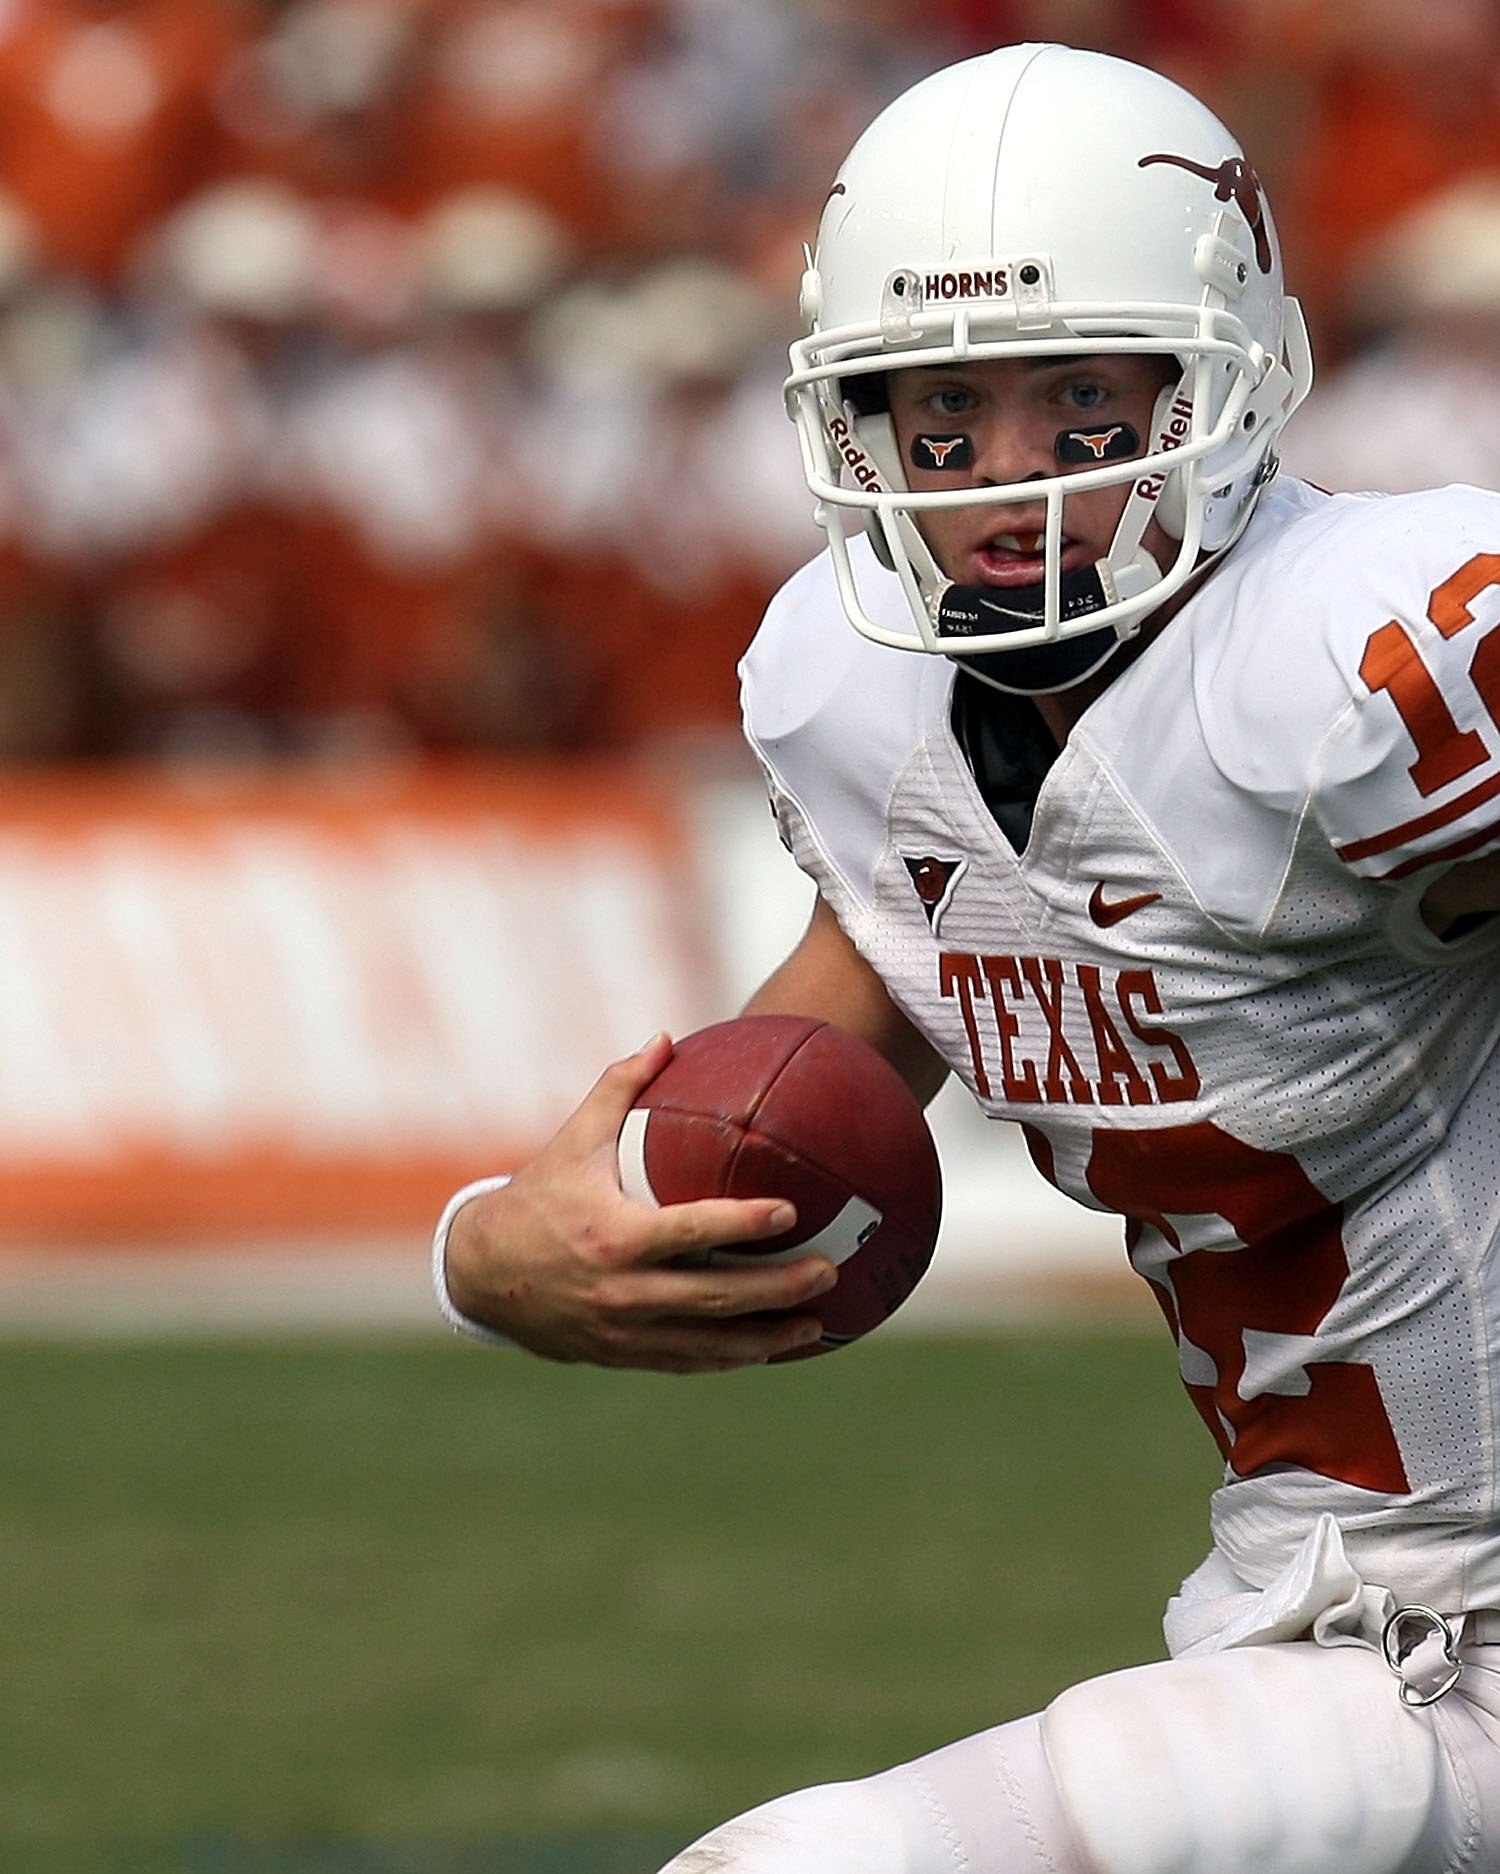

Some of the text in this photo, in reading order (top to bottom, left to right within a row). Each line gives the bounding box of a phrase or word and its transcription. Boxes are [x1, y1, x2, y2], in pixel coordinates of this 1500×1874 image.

[925, 270, 1008, 300] HORNS
[1136, 397, 1194, 501] Ridell
[939, 951, 1201, 1106] TEXAS
